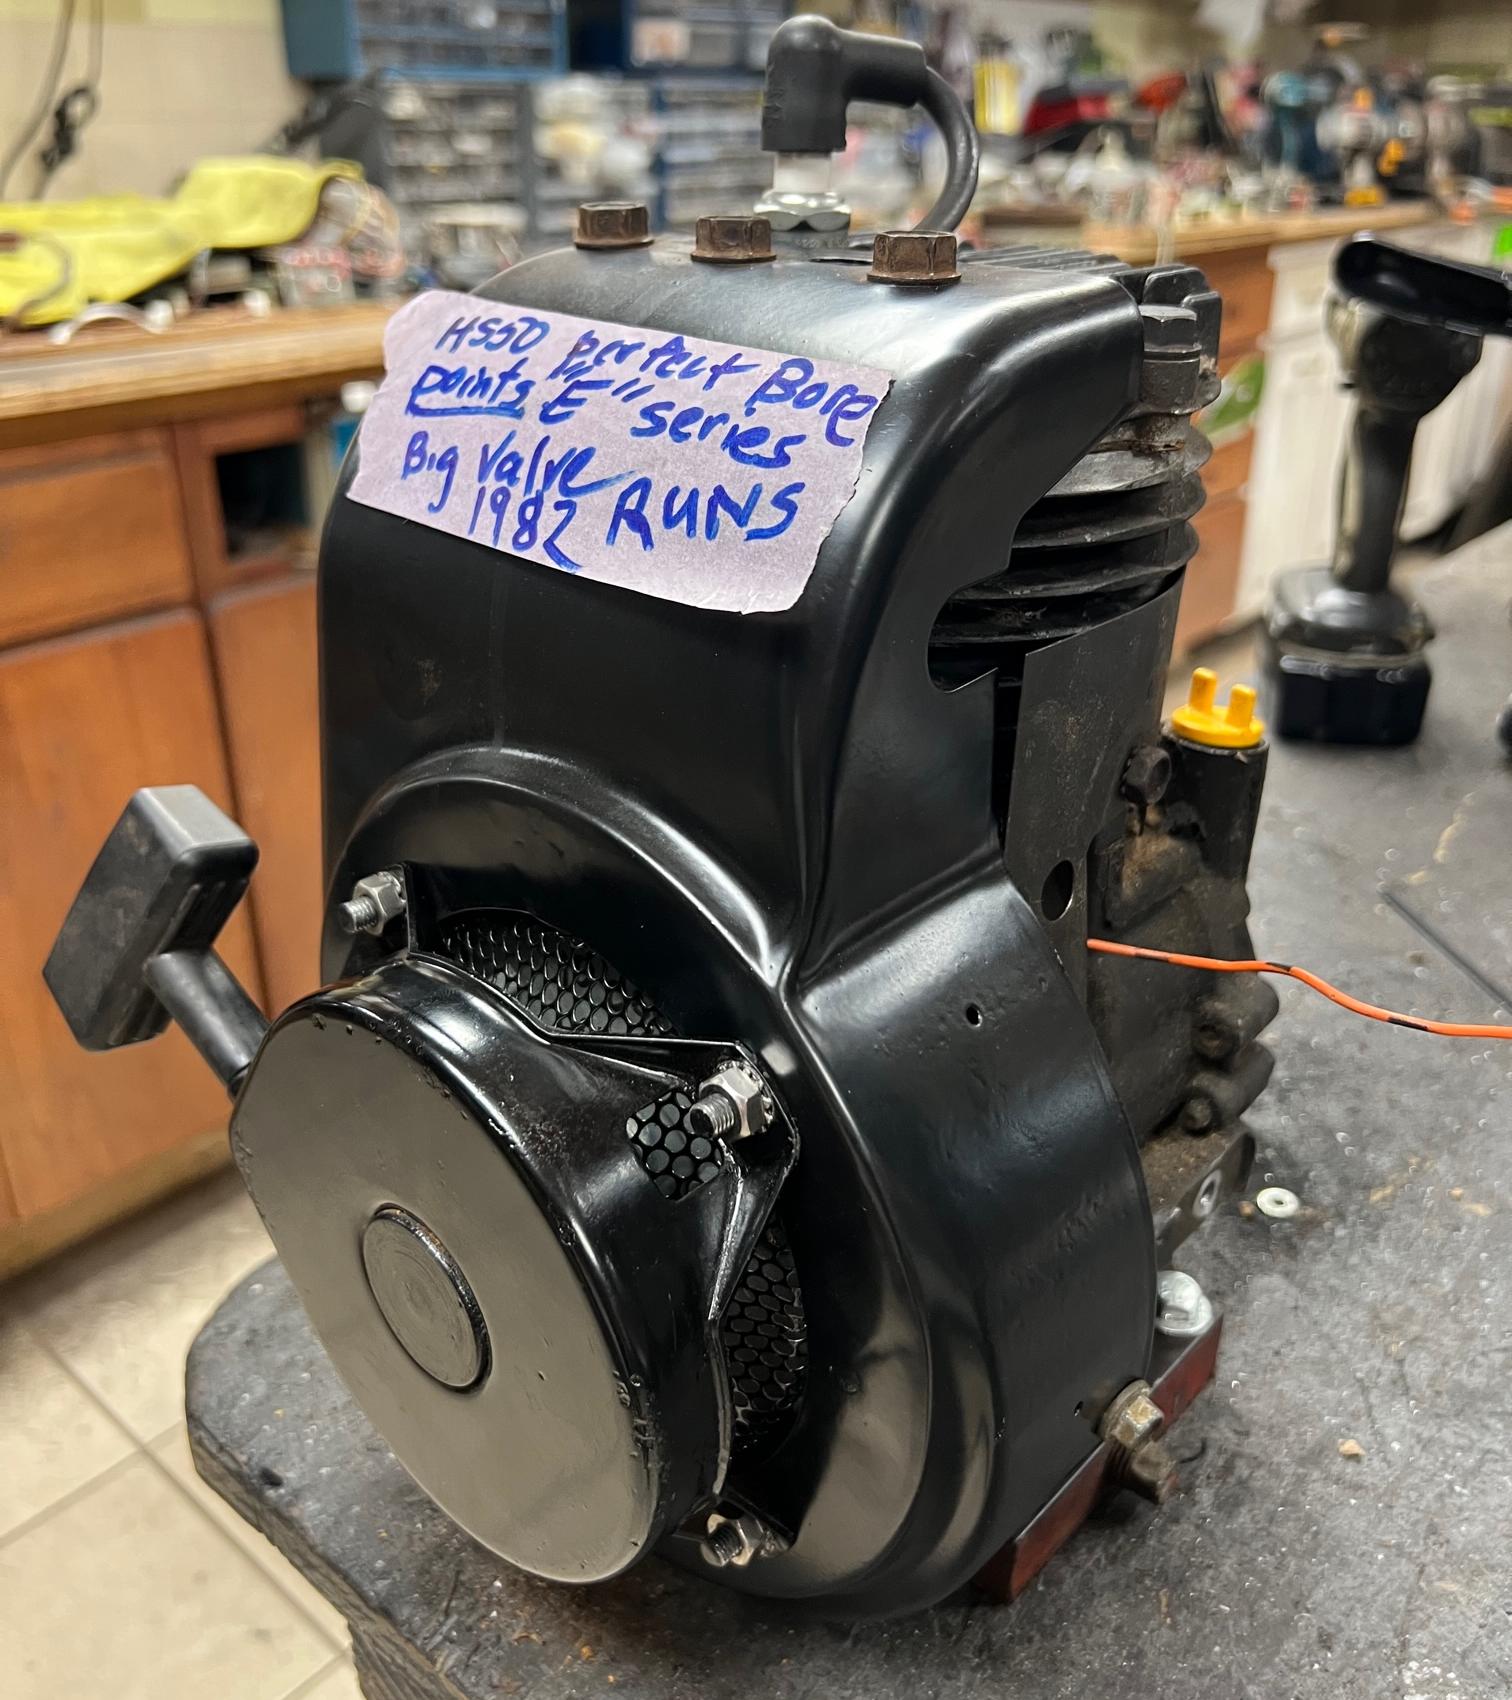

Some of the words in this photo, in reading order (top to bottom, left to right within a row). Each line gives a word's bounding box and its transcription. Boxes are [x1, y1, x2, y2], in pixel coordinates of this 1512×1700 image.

[630, 401, 807, 469] series
[744, 358, 880, 447] Bore
[401, 430, 459, 514] Big
[467, 486, 583, 574] 1982
[605, 476, 806, 551] RUNS
